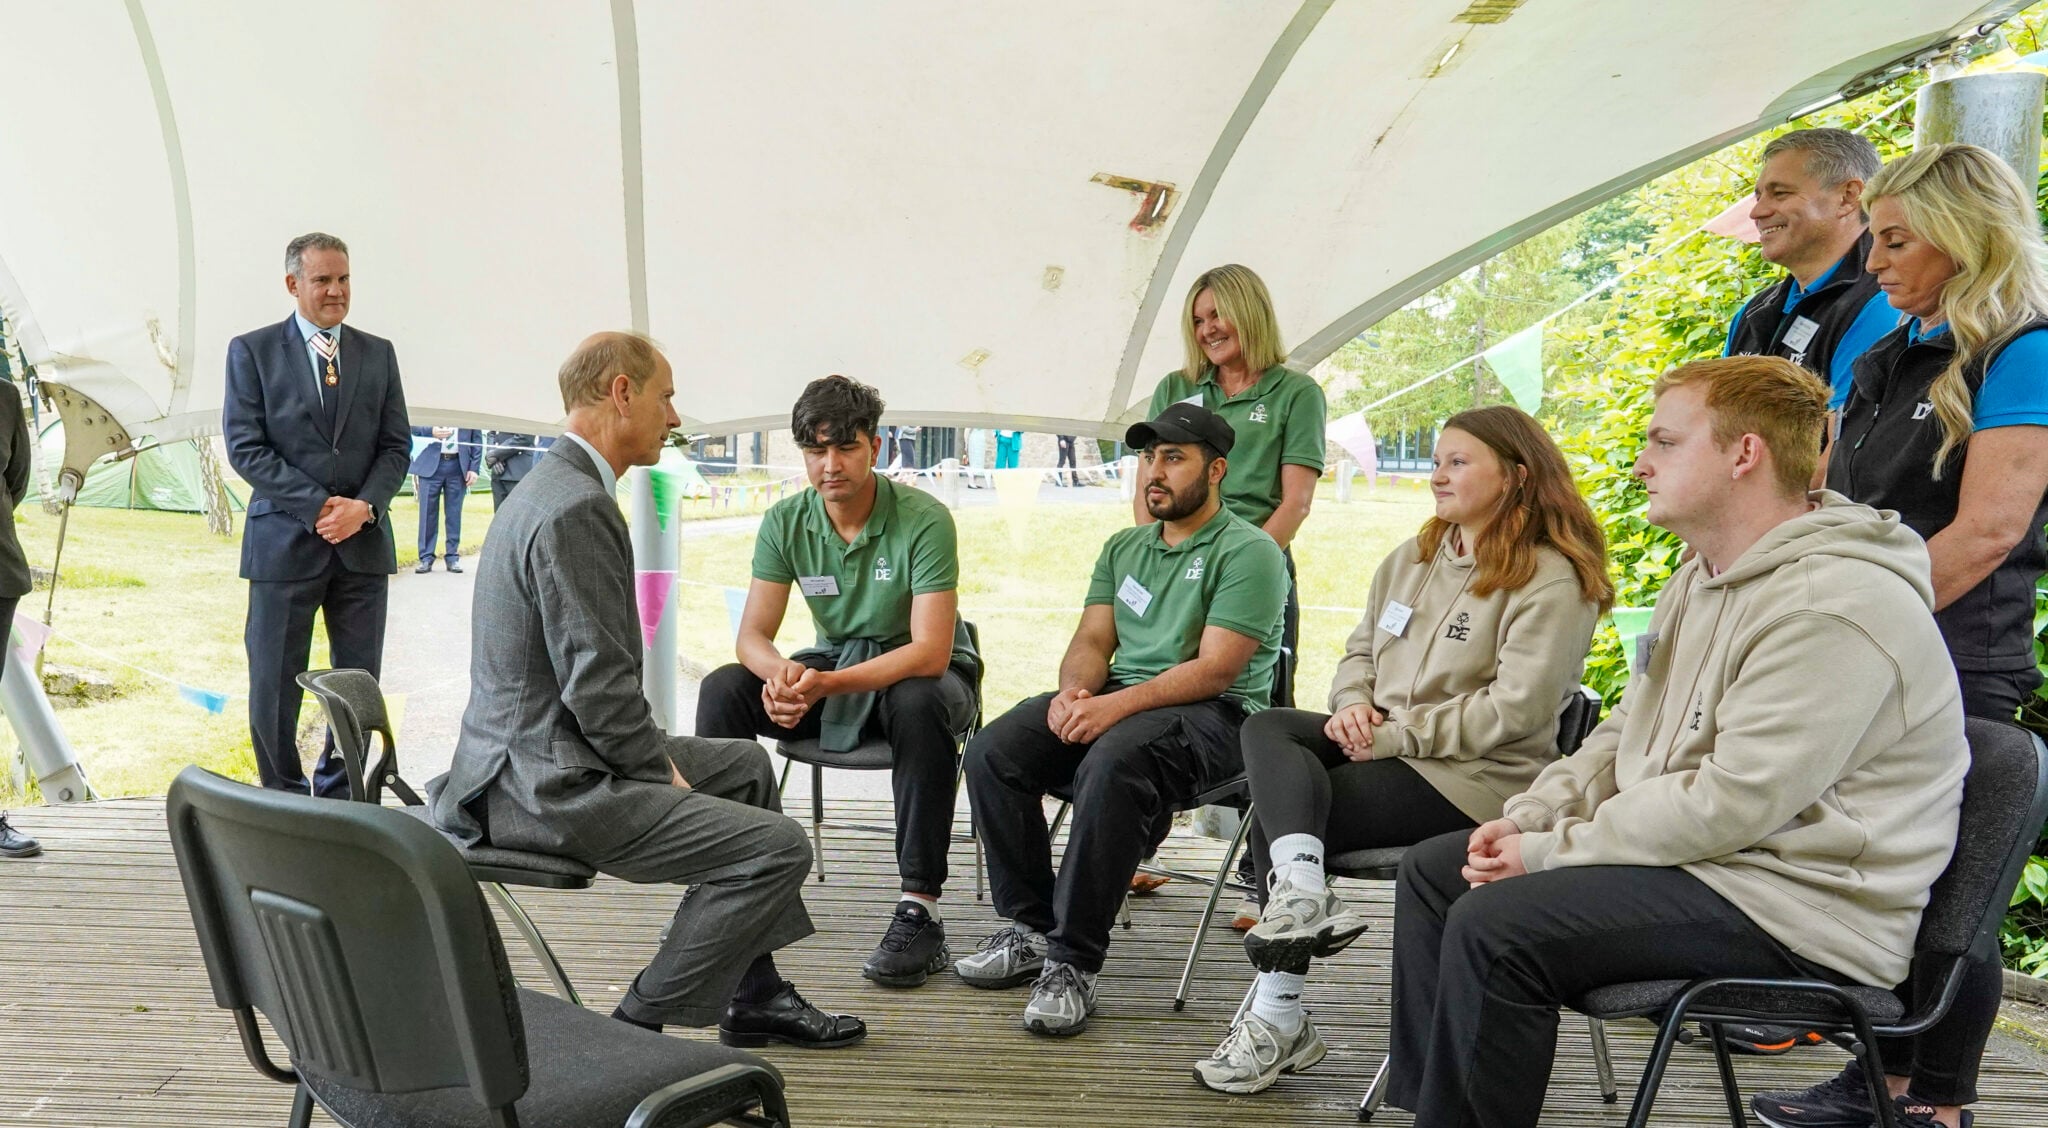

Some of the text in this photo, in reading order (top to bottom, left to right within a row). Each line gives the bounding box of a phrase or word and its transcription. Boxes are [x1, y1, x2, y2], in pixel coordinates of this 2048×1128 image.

[1248, 412, 1268, 424] DE
[875, 569, 892, 581] DE
[1184, 568, 1204, 580] DE
[1445, 624, 1470, 642] DE
[1904, 1105, 1934, 1115] HOKA
